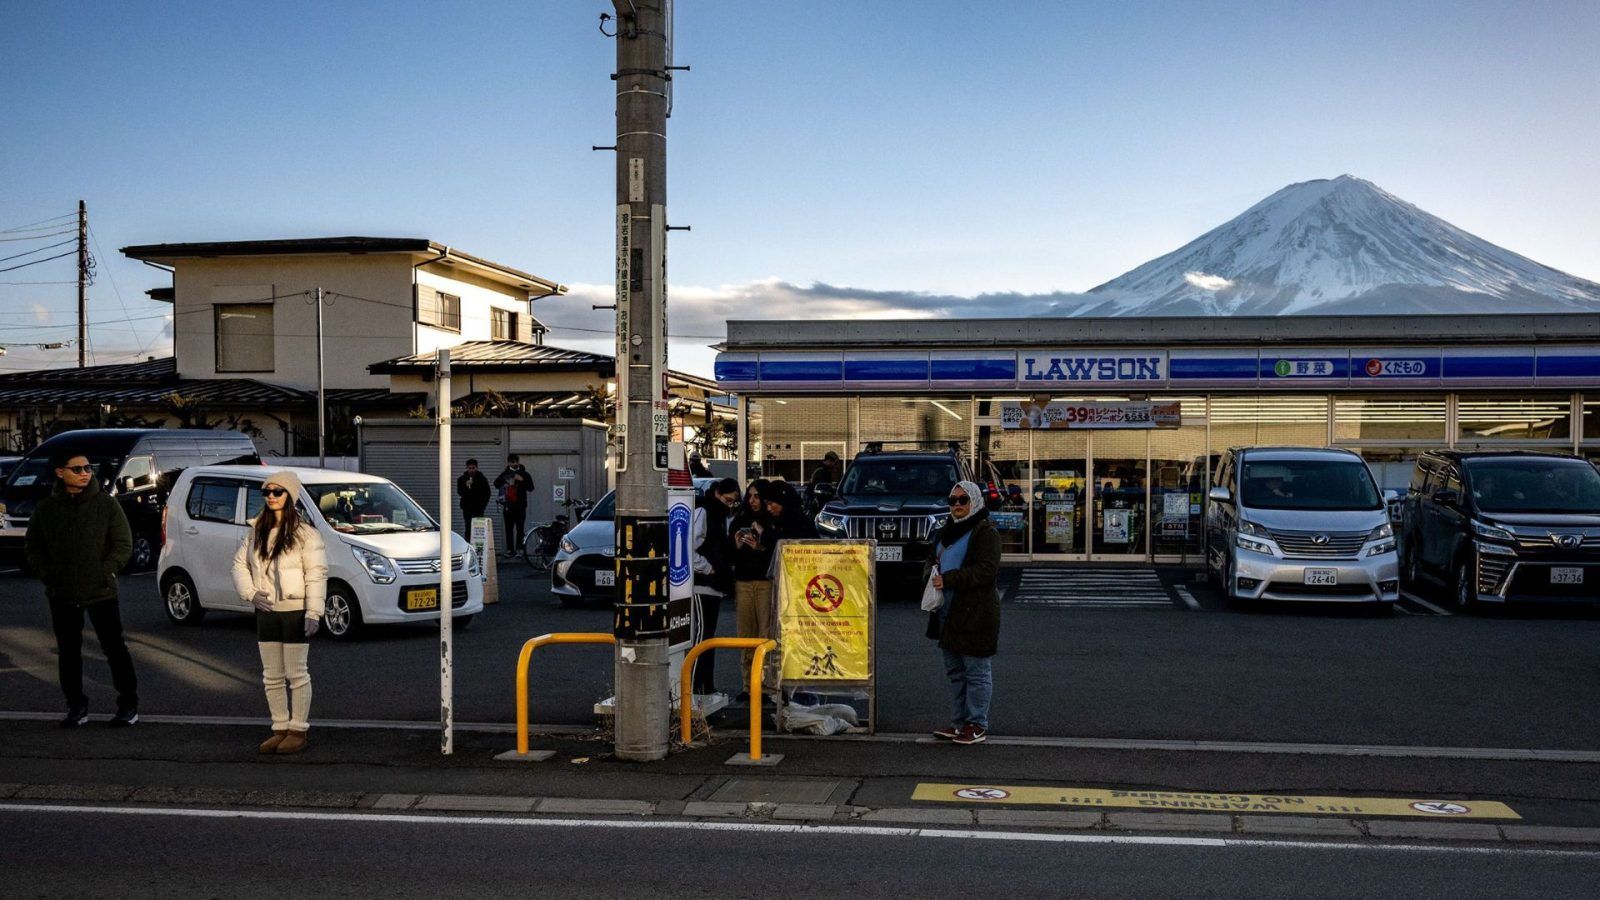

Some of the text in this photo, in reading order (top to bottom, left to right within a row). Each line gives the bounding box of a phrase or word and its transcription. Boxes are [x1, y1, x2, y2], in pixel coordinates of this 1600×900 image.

[1025, 358, 1160, 380] LAWSON
[1296, 362, 1327, 374] 野菜
[1384, 361, 1422, 374] くだもの
[1066, 407, 1088, 422] 39
[879, 552, 900, 560] 23-17
[1312, 576, 1335, 584] 26-40
[414, 597, 435, 608] 72-29
[1111, 790, 1250, 802] Crossing
[1138, 800, 1280, 810] WARNING
